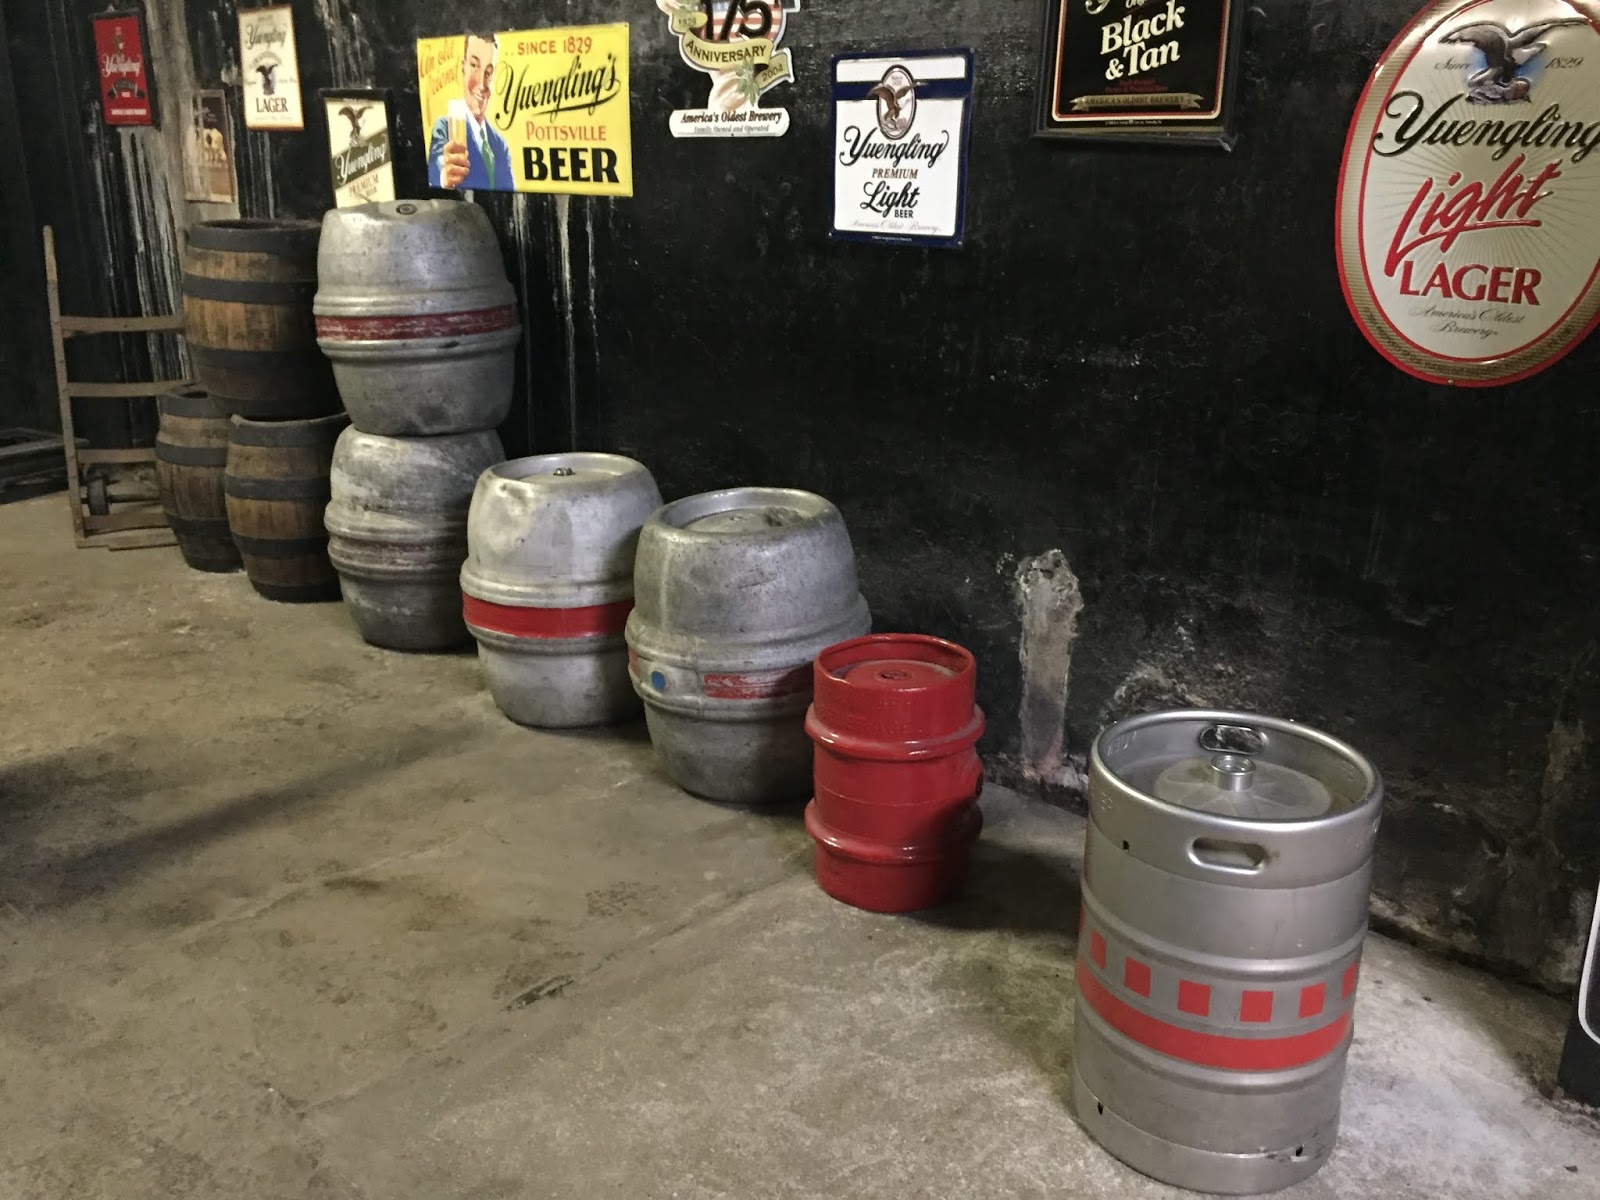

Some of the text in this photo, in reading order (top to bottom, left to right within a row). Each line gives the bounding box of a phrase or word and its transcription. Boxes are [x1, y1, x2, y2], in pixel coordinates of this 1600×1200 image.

[517, 36, 593, 56] SINCE 1829
[1100, 0, 1186, 55] Black
[685, 40, 767, 63] ANNIVERSARY
[1105, 40, 1180, 80] & Tan
[1434, 55, 1584, 71] Since 1829
[255, 97, 289, 113] LAGER
[494, 53, 622, 131] Yuengling's
[525, 120, 607, 142] POTTSVILLE
[680, 111, 782, 125] America's Oldest Brewery
[1372, 89, 1600, 164] Yuengling
[335, 133, 388, 186] Yuengling
[522, 146, 620, 184] BEER
[839, 125, 950, 169] Yuengling
[871, 168, 919, 180] PREMIUM
[859, 180, 920, 219] Light
[894, 209, 914, 219] BEER
[1384, 153, 1562, 278] Light
[1400, 260, 1540, 306] LAGER
[1409, 305, 1526, 324] America's Oldest
